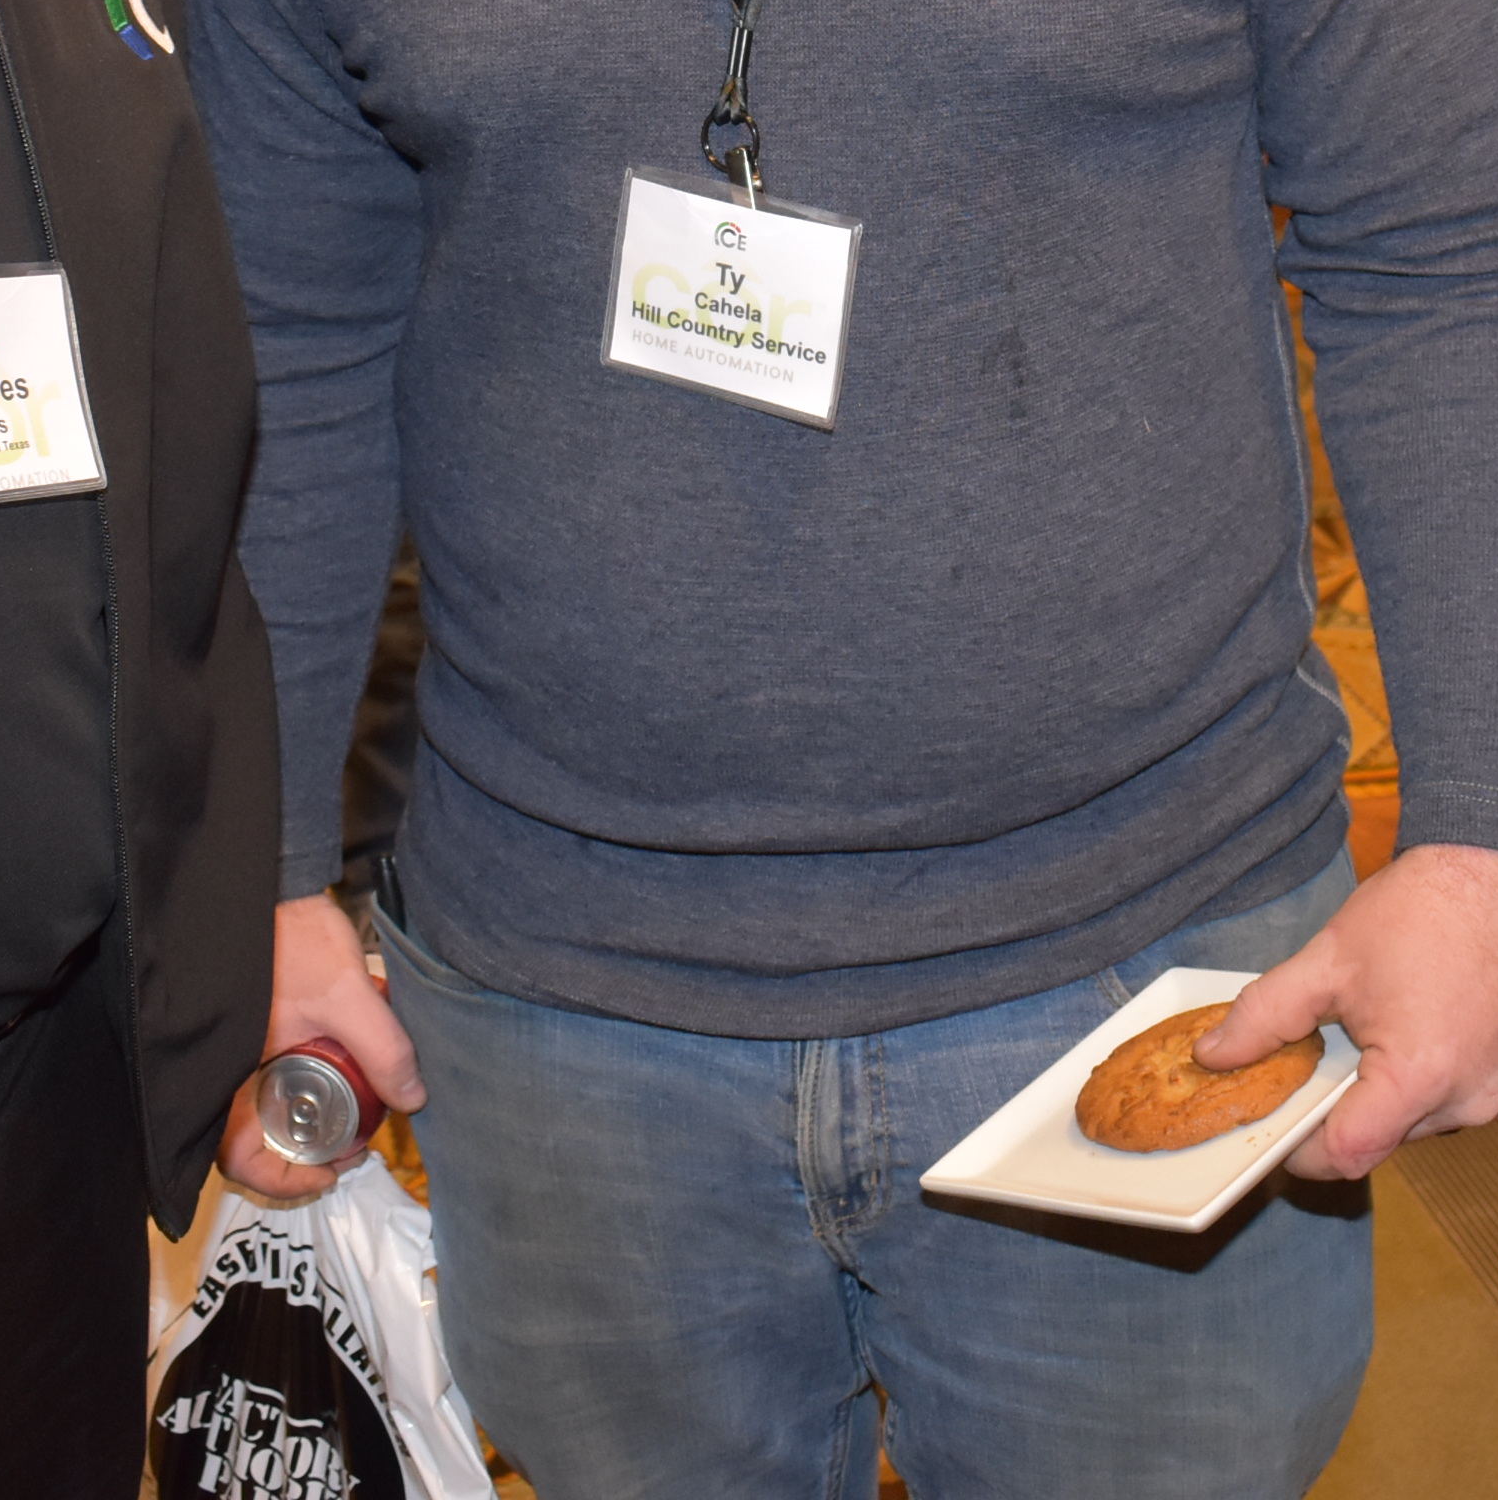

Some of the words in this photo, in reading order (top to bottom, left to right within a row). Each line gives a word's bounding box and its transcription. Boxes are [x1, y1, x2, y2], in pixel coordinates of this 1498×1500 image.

[715, 262, 746, 295] Ty
[694, 292, 763, 324] Cahela
[631, 300, 662, 325] Hill
[666, 311, 745, 349] Country
[751, 331, 827, 365] Service
[632, 329, 679, 354] HOME
[684, 344, 795, 384] AUTOMATION
[2, 439, 31, 452] Texas
